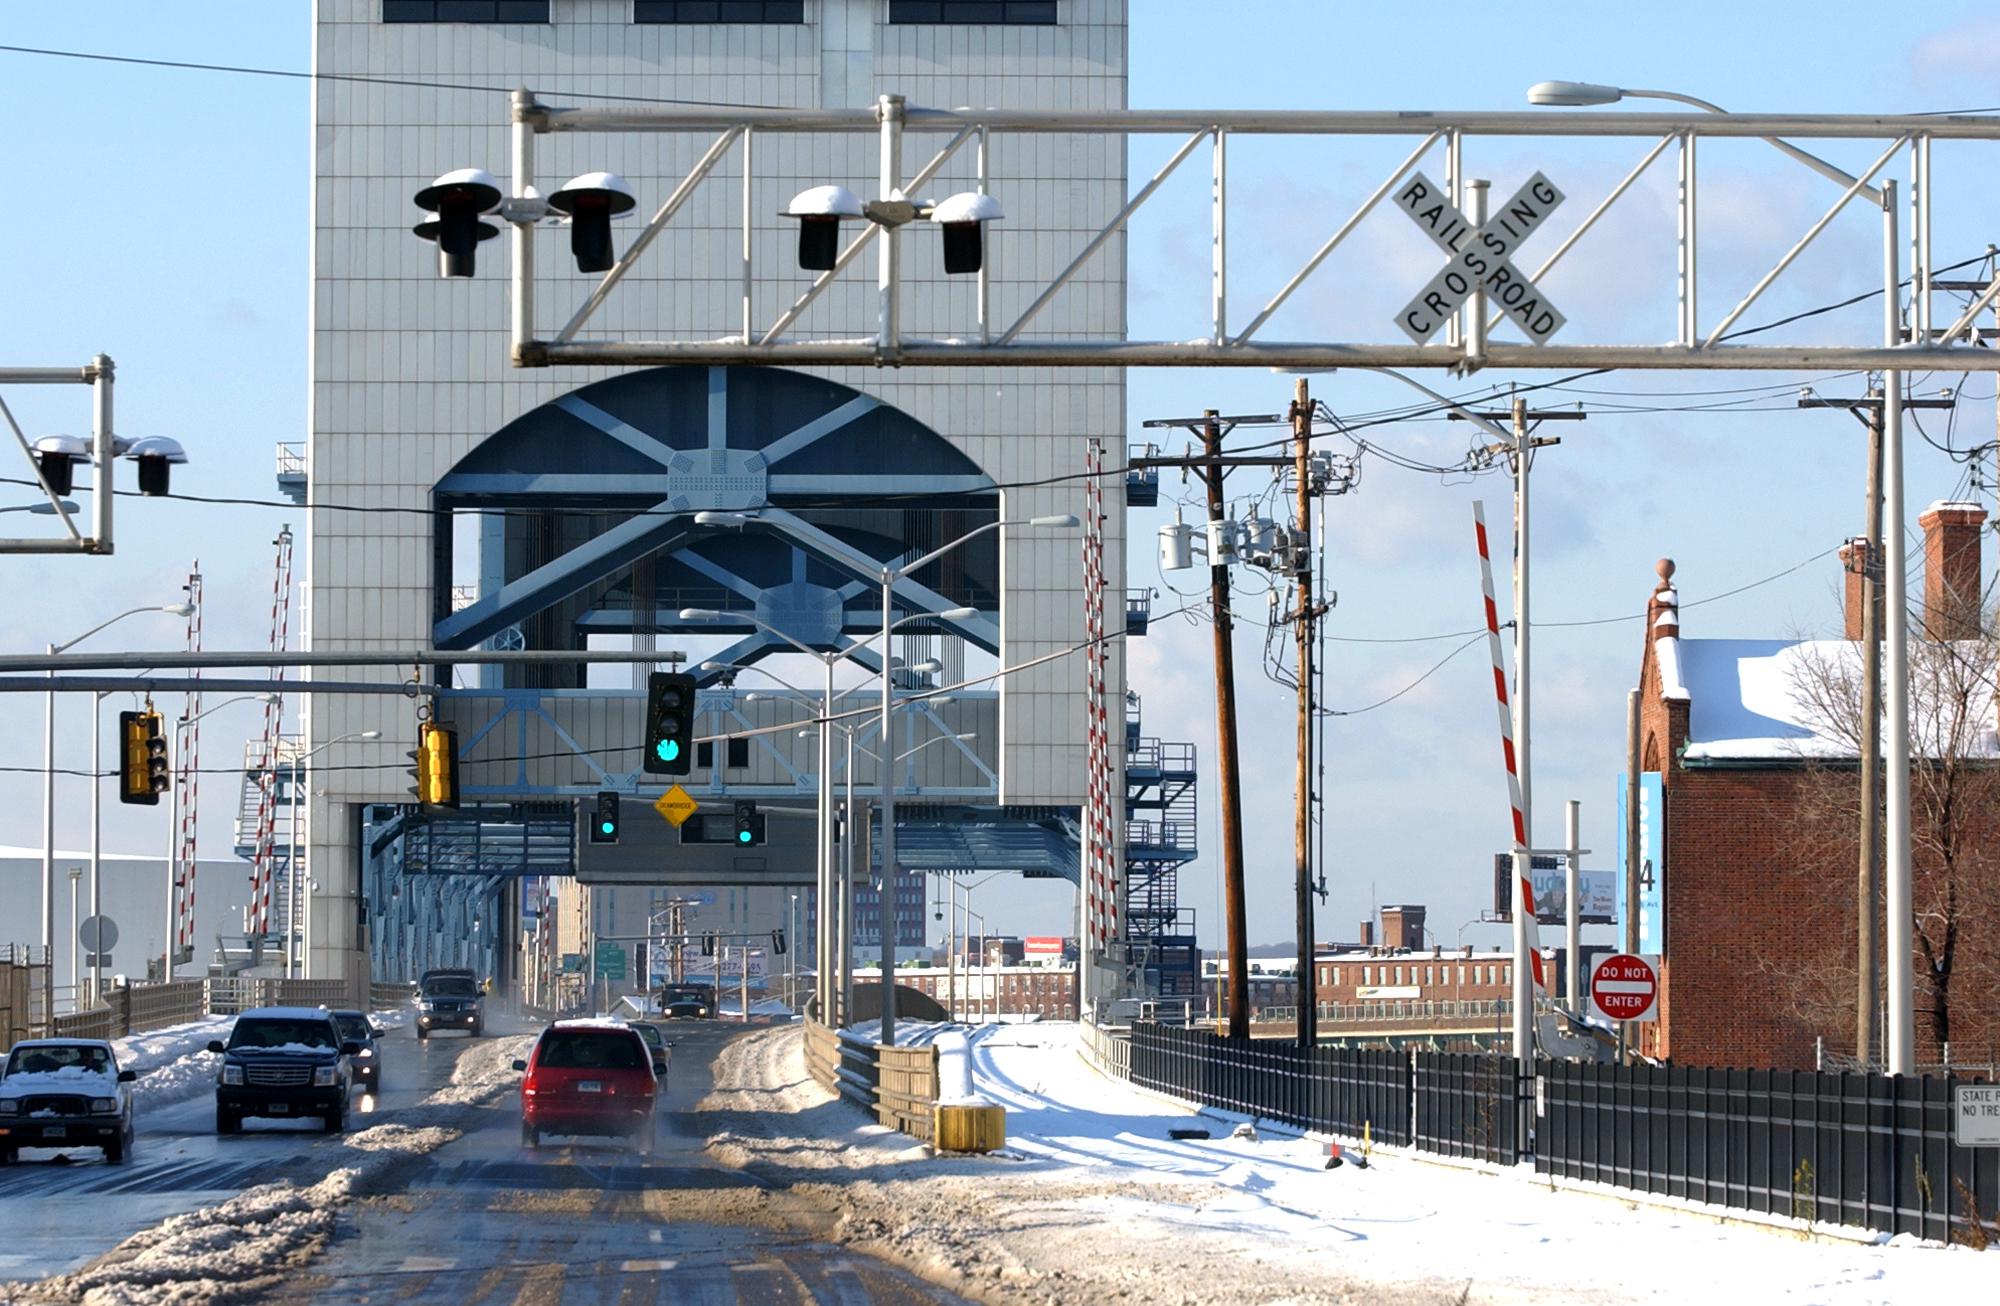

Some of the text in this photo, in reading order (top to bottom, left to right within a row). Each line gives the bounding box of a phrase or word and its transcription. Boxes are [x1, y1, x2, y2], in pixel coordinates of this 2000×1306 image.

[1407, 182, 1555, 334] CROSSING
[1601, 966, 1648, 979] DO NOT
[1605, 995, 1643, 1007] ENTER
[1962, 1090, 1992, 1102] STATE
[1962, 1104, 2000, 1117] NO TRE
